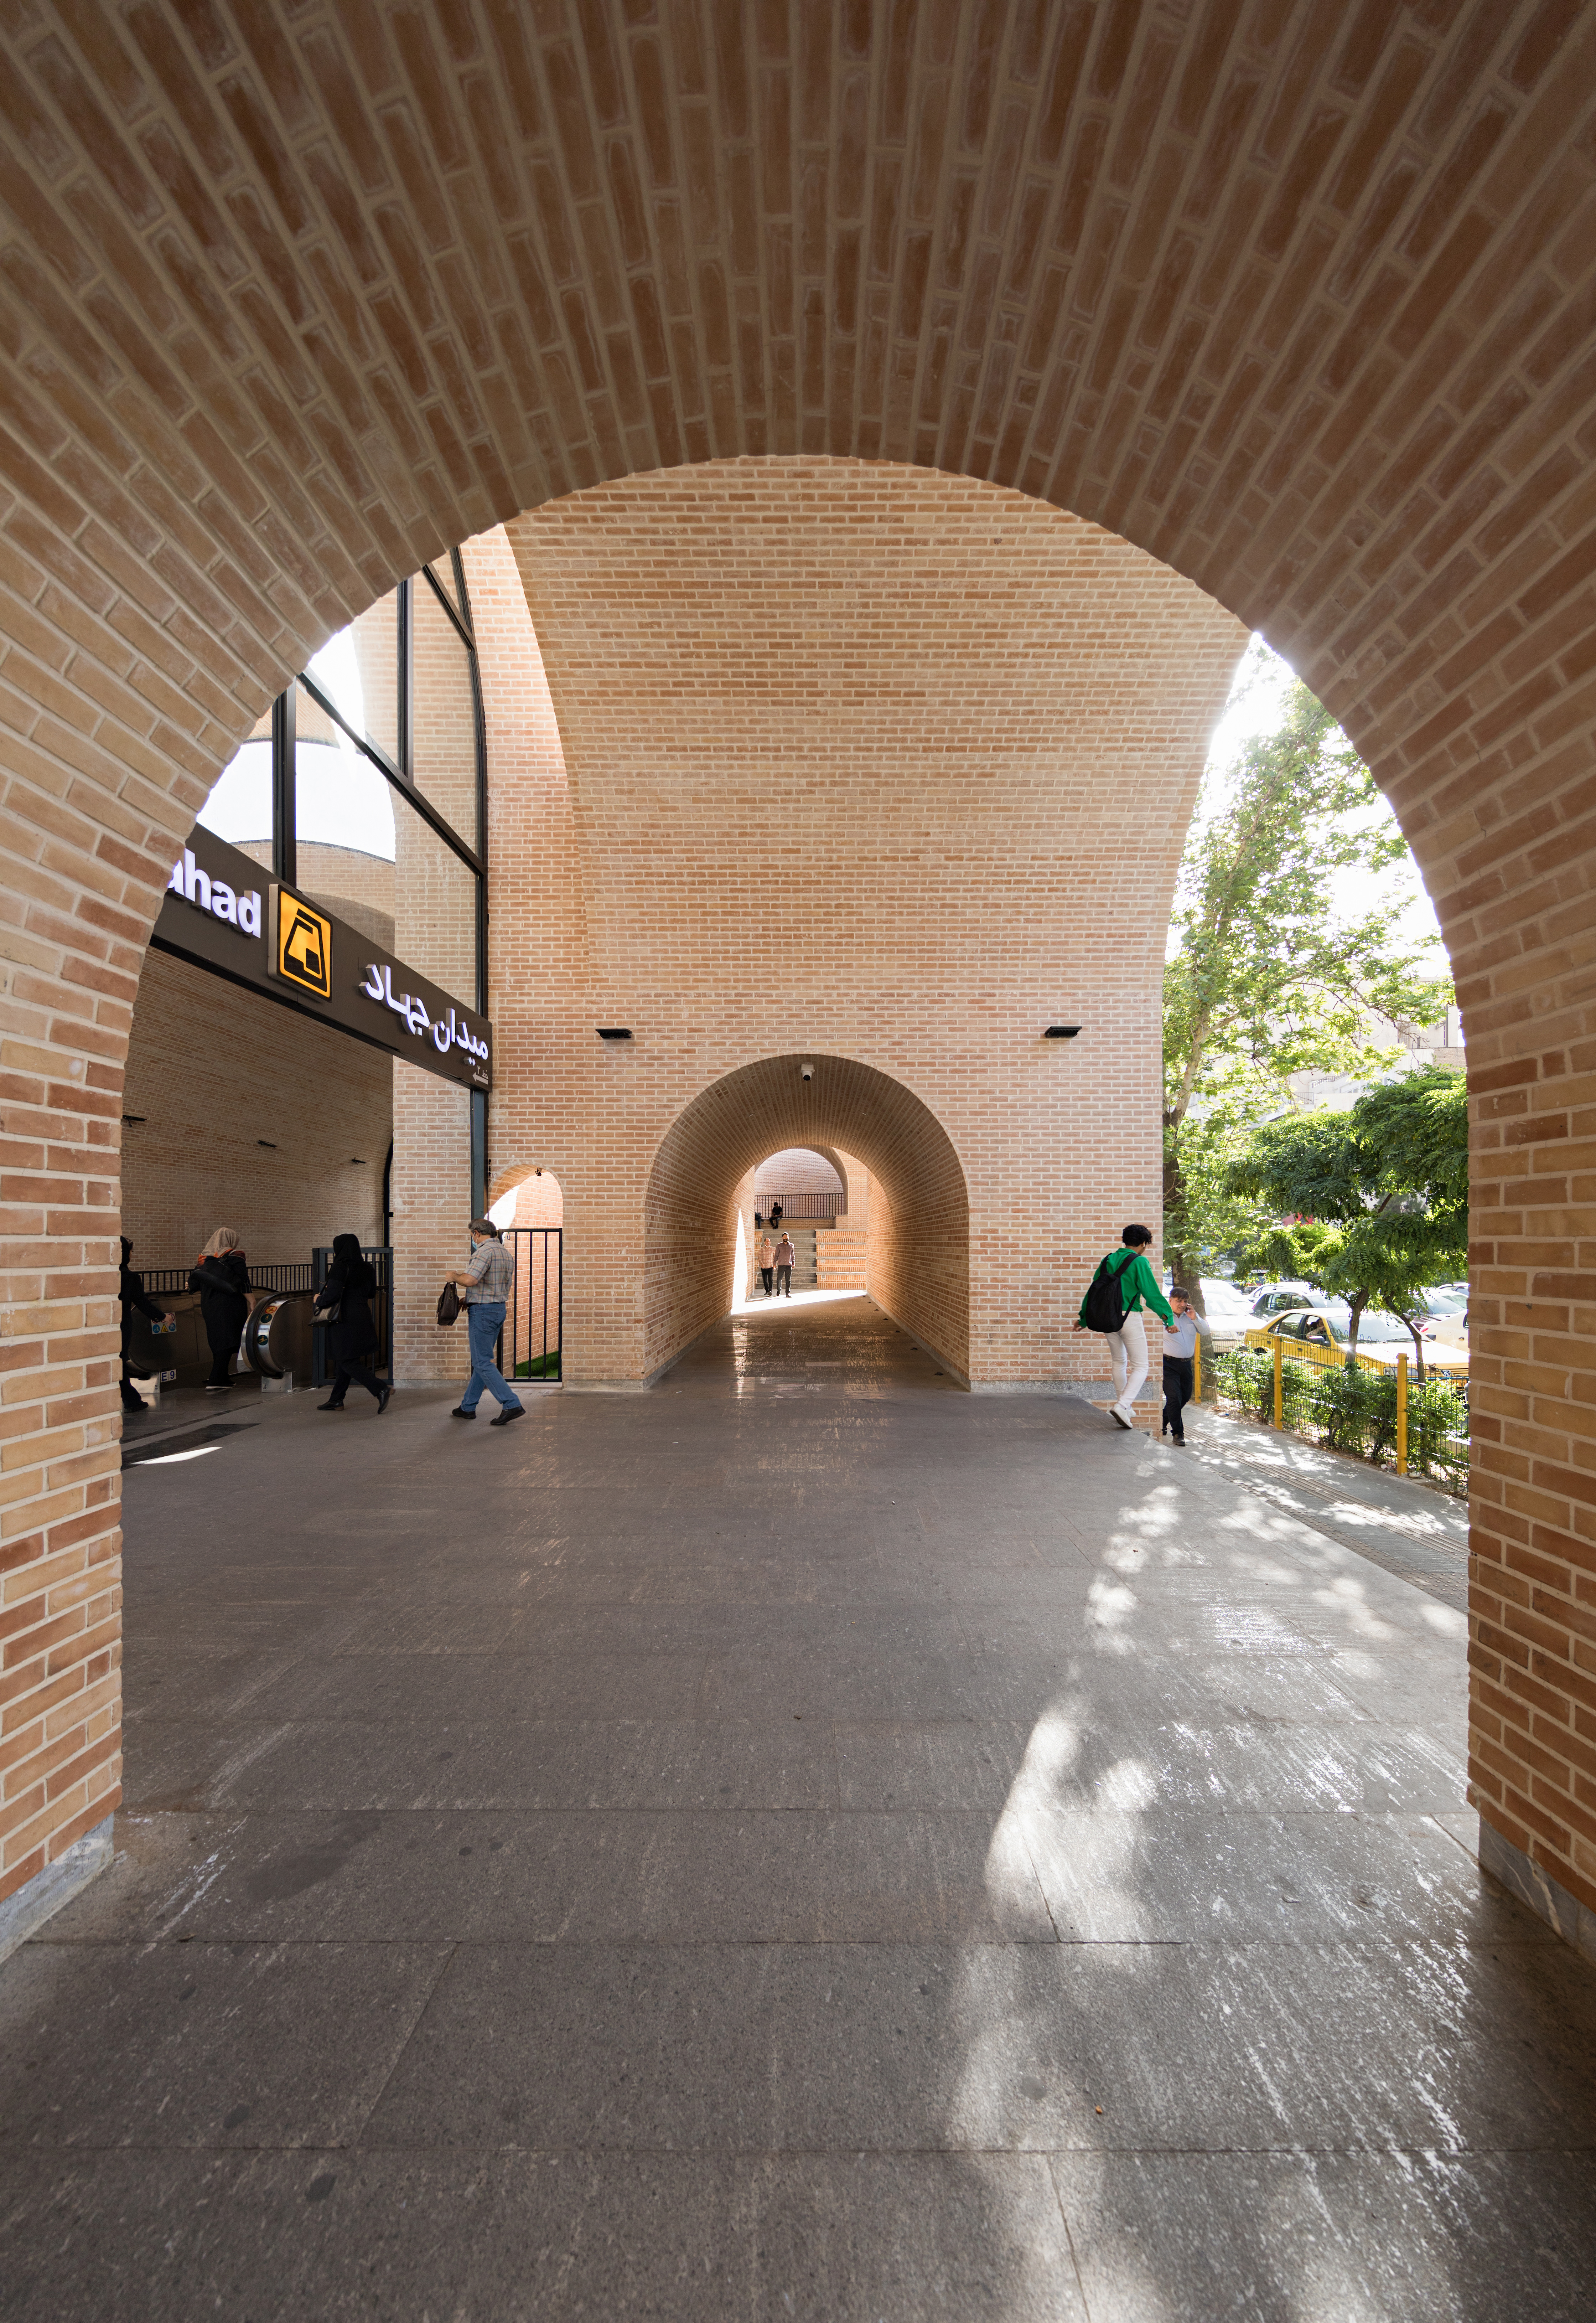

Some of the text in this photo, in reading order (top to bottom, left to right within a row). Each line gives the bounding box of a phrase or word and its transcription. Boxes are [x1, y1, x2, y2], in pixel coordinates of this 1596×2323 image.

[363, 964, 488, 1066] میدان جهاد
[482, 1069, 488, 1079] خط
